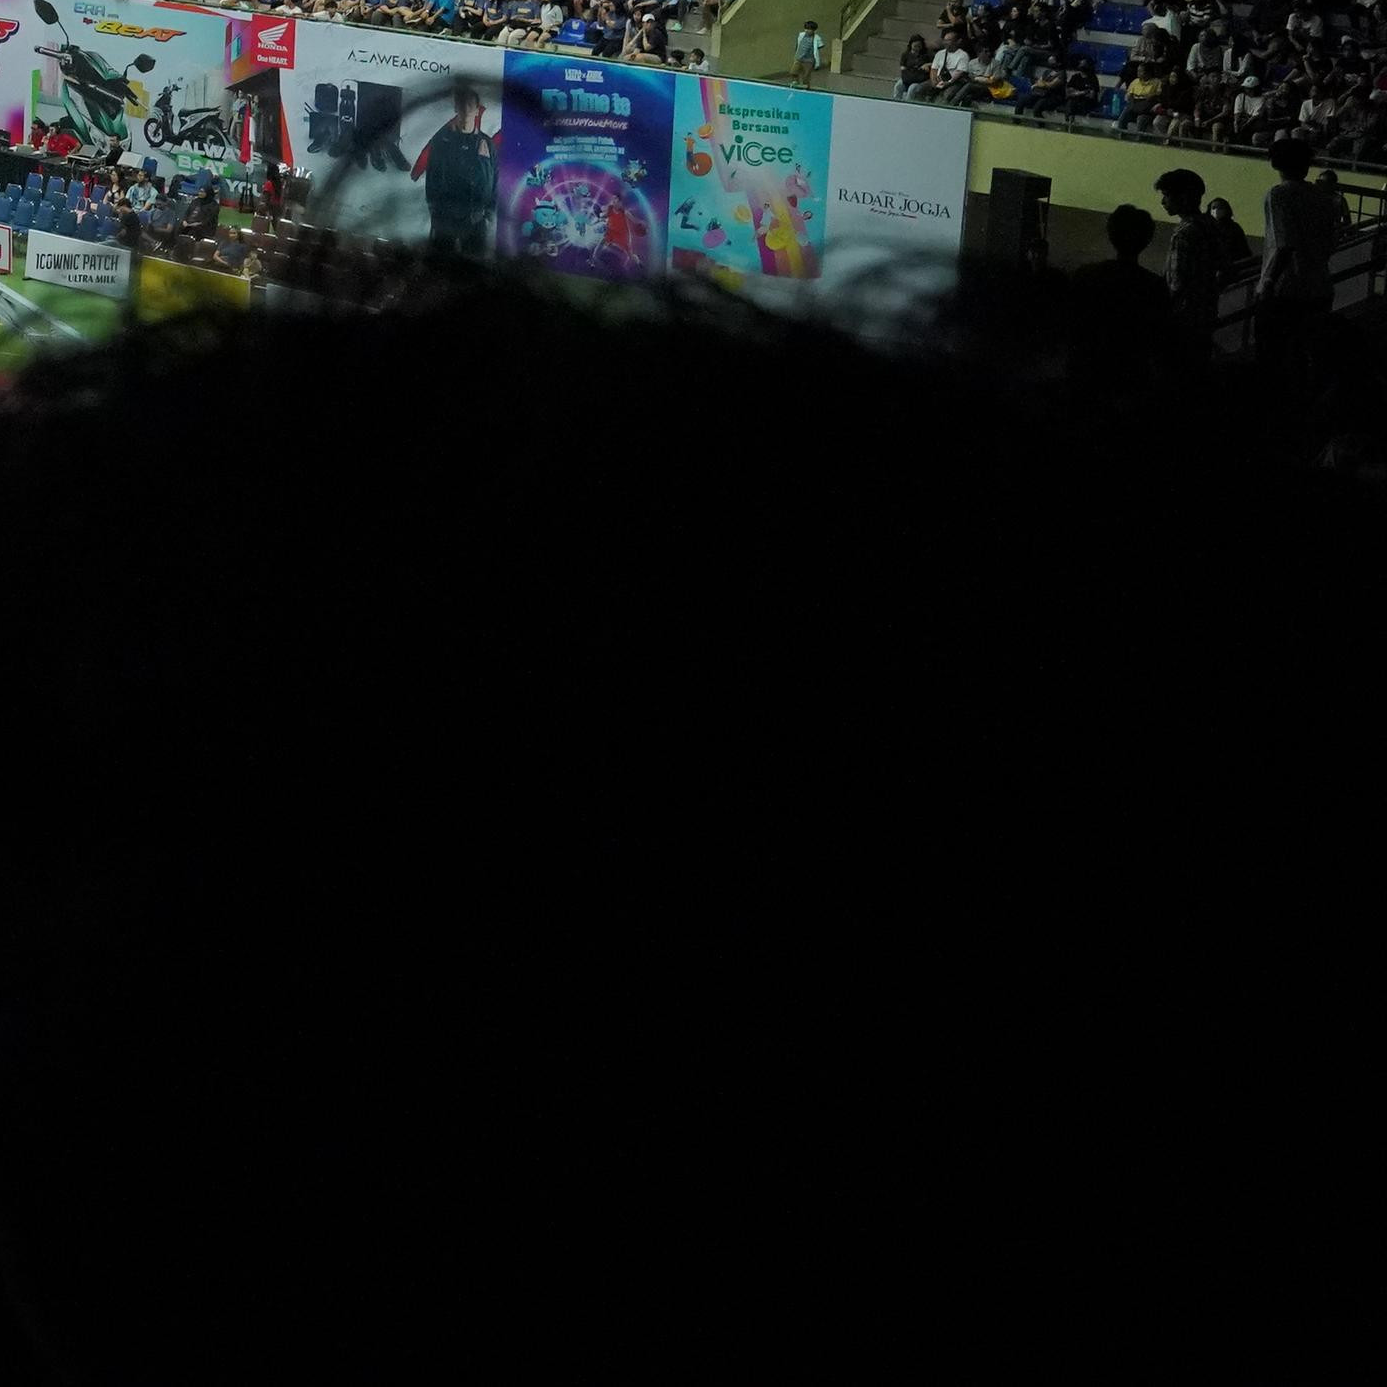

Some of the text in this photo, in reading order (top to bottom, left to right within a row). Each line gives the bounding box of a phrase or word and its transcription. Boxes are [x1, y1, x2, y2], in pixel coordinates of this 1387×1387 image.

[74, 2, 106, 16] ERA
[257, 41, 288, 52] HONDA
[256, 54, 268, 63] One
[718, 103, 800, 121] Ekspresikan
[732, 120, 789, 135] Bersama
[838, 188, 896, 210] RADAR
[898, 198, 952, 220] JOGJA
[36, 253, 120, 272] ICOWNIC PATCH
[68, 273, 116, 285] ULTRA MILK
